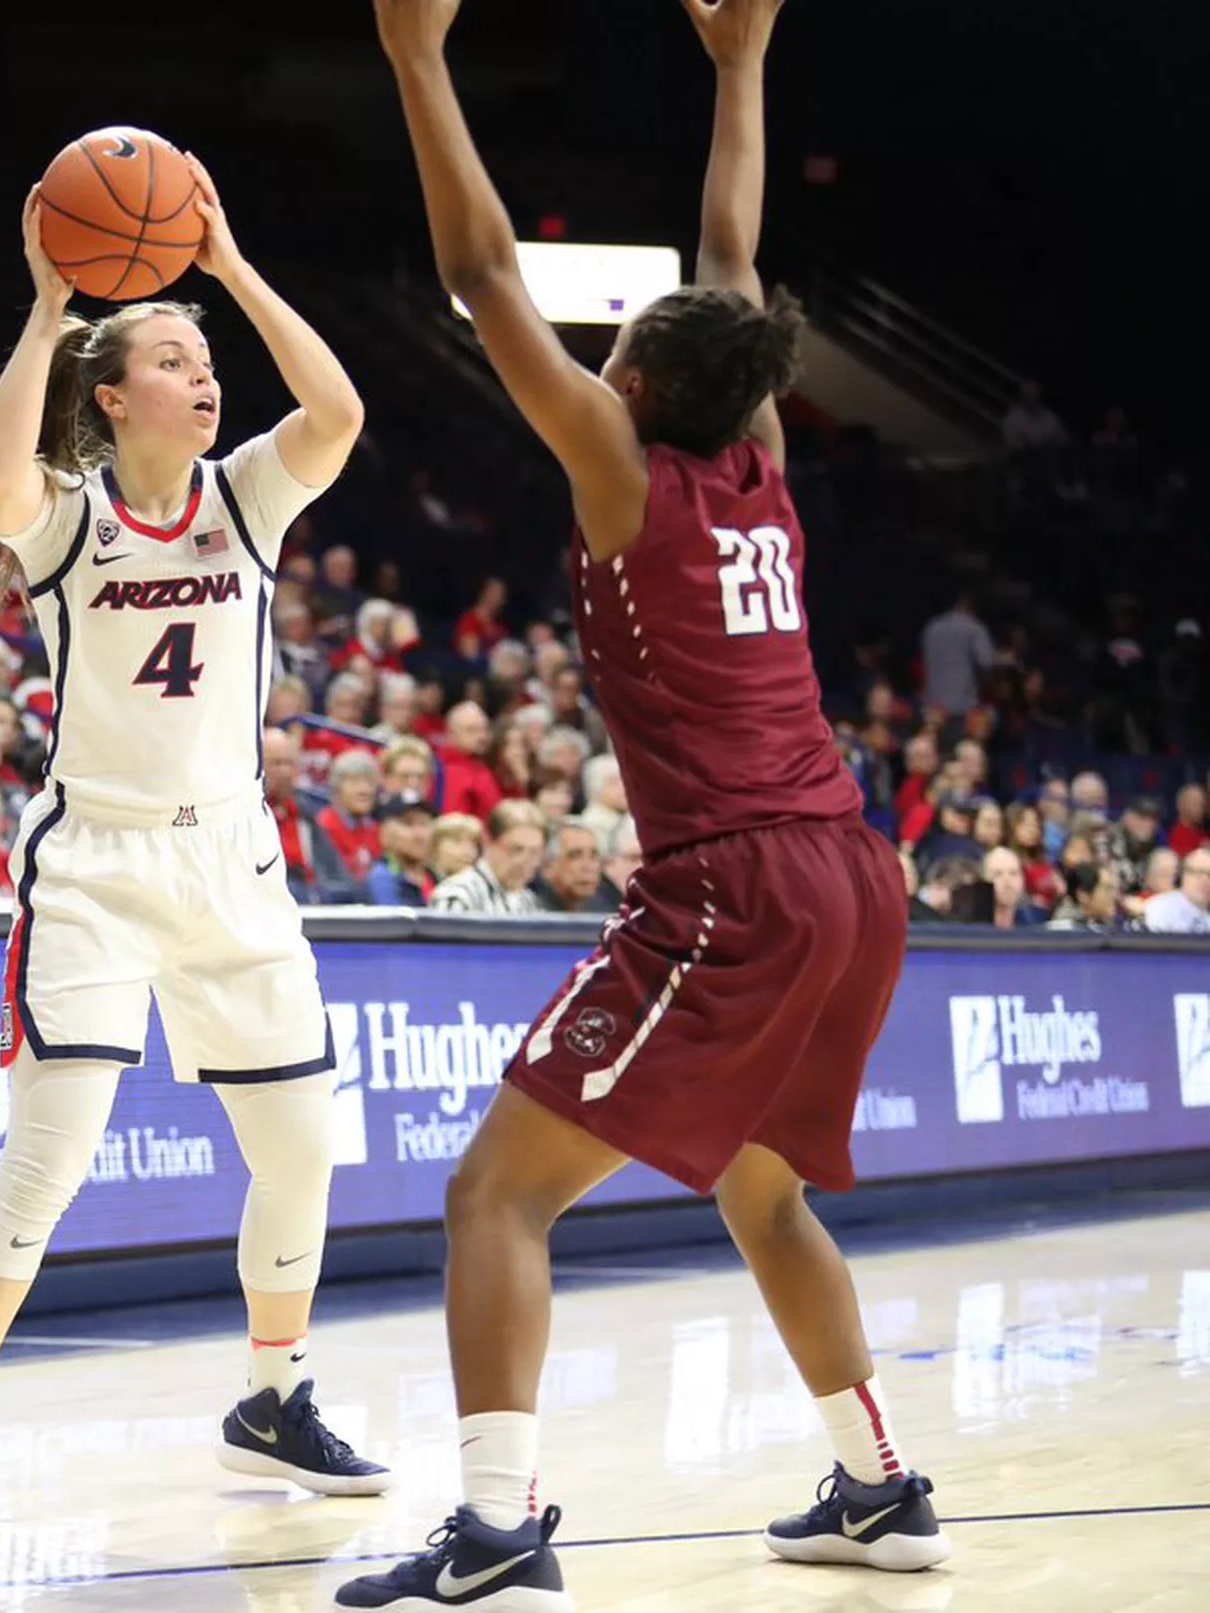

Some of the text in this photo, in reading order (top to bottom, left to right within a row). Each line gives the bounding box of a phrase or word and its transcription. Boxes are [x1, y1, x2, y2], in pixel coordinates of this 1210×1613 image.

[87, 571, 243, 610] ARIZONA
[711, 525, 802, 636] 20
[132, 622, 205, 698] 4
[998, 995, 1102, 1084] Hughes
[127, 1126, 216, 1180] Union
